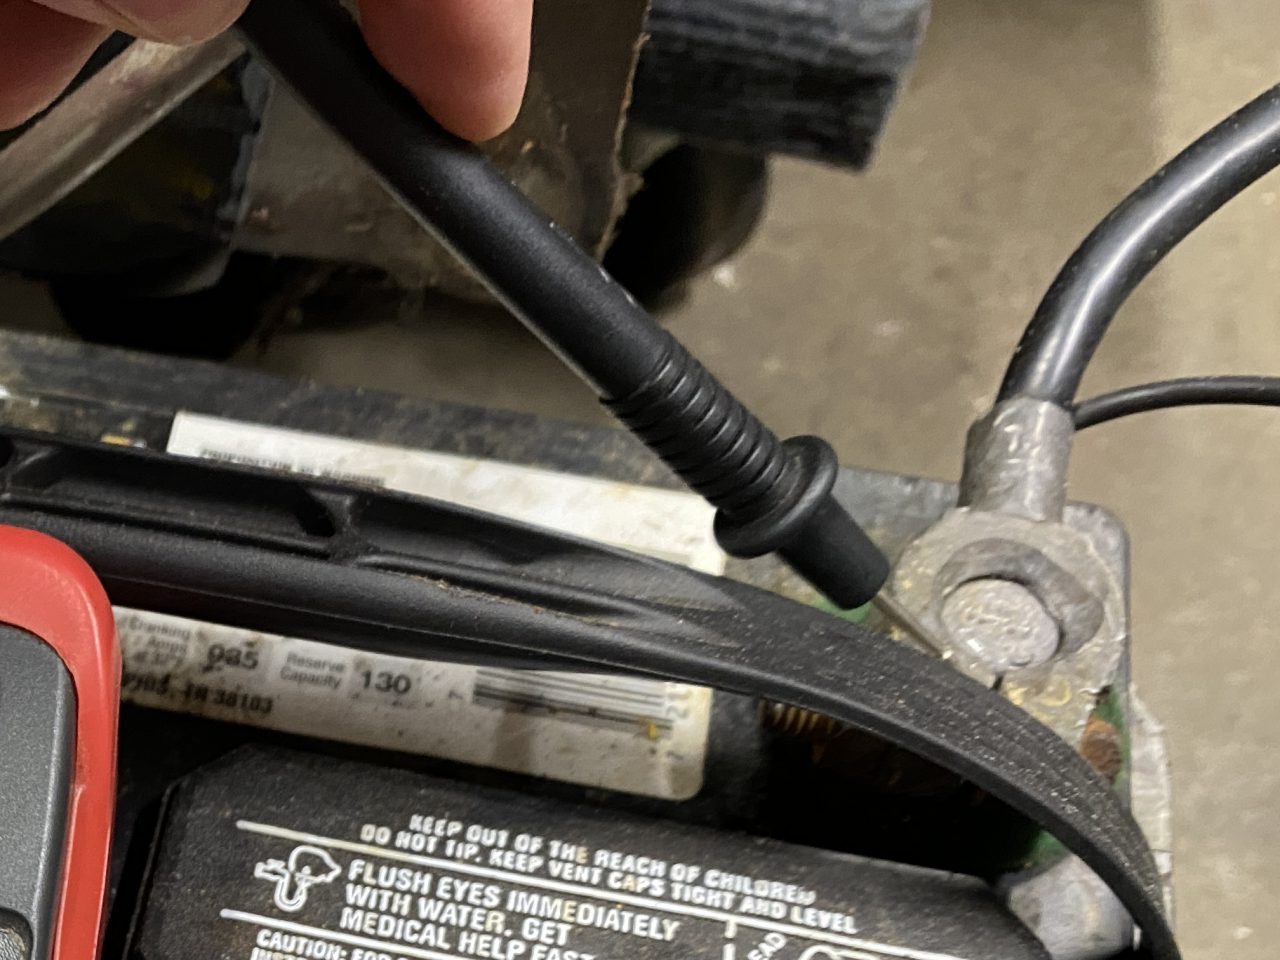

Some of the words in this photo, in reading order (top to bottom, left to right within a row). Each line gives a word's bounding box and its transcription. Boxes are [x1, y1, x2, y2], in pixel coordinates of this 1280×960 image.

[280, 665, 342, 690] Capacity
[287, 652, 345, 673] Reserve
[362, 670, 411, 694] 130
[360, 824, 391, 845] DO
[395, 830, 439, 854] NOT
[445, 839, 482, 863] TIP.
[488, 849, 544, 872] KEEP
[549, 859, 602, 885] VENT
[608, 871, 667, 897] CAPS
[670, 882, 736, 910] TIGHT
[739, 896, 787, 920] AND
[790, 906, 858, 934] LEVEL
[409, 814, 463, 836] KEEP
[466, 824, 509, 848] OUT
[514, 834, 544, 854] OF
[548, 839, 588, 864] THE
[594, 849, 666, 878] REACH
[671, 863, 701, 883] OF
[704, 869, 816, 905] CHILDREN
[346, 883, 412, 916] WITH
[522, 917, 572, 946] GET
[348, 859, 432, 895] FLUSH
[436, 876, 501, 908] EYES
[506, 890, 680, 942] IMMEDIATELY
[340, 907, 451, 950] MEDICAL
